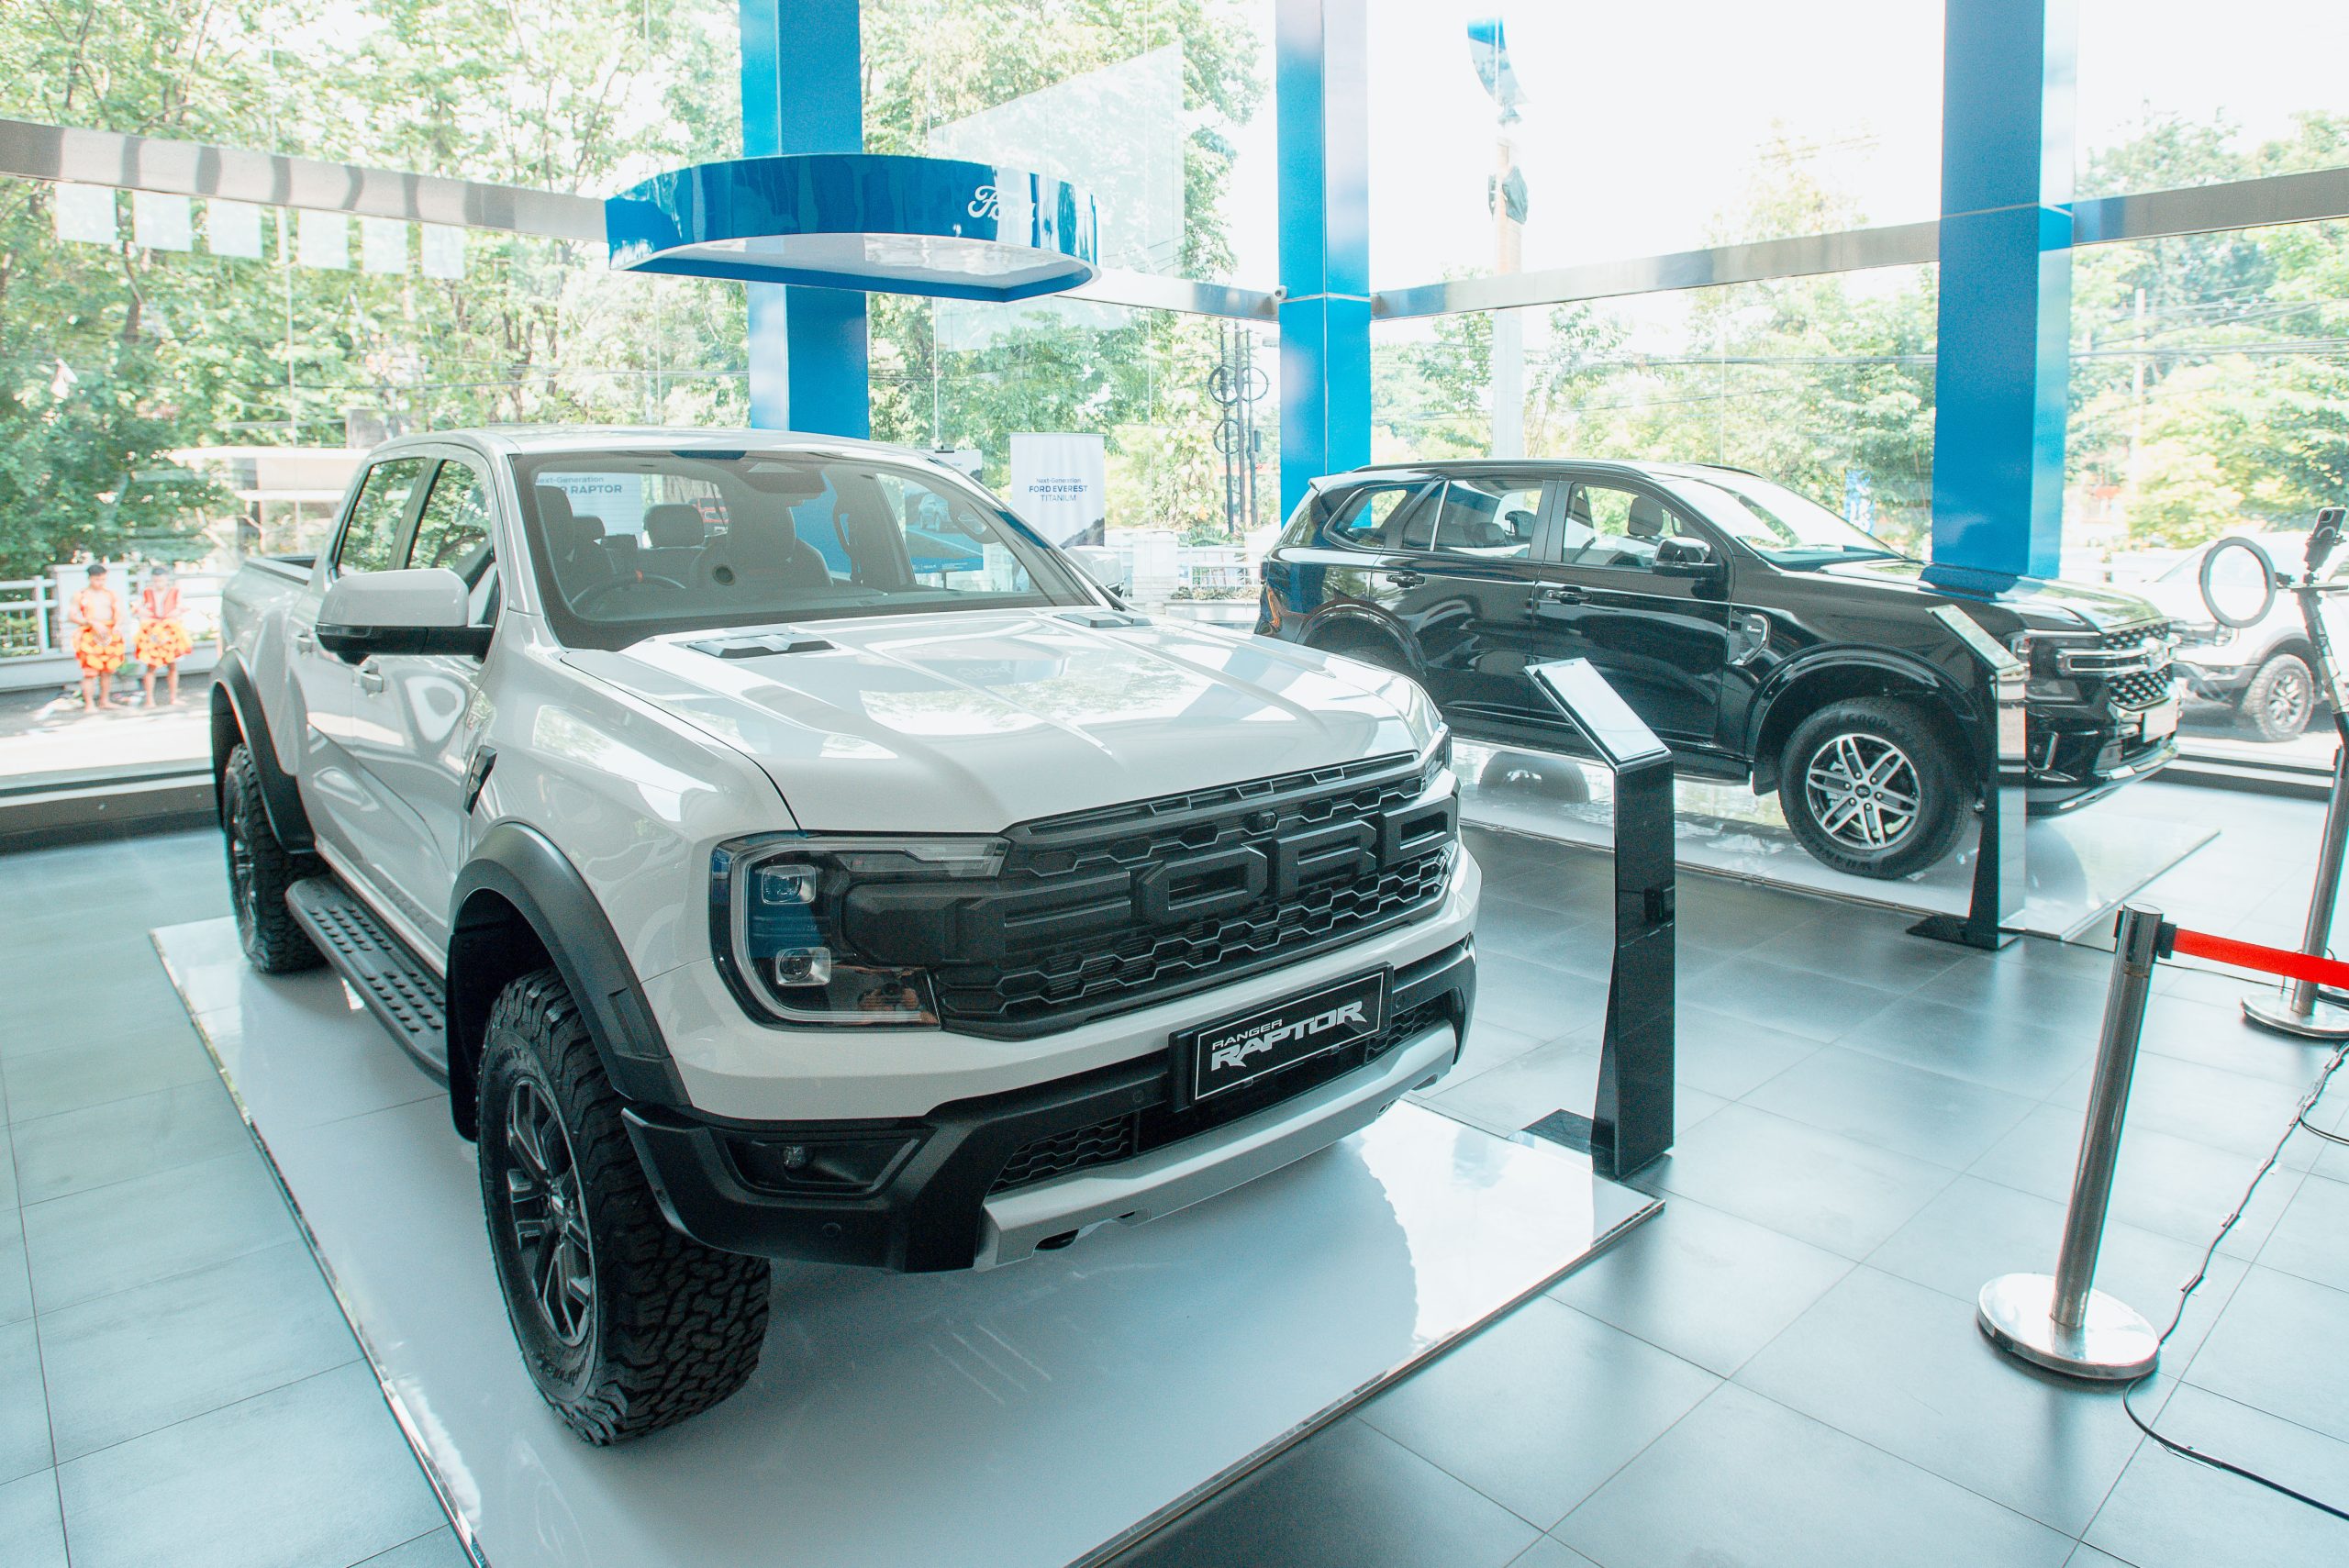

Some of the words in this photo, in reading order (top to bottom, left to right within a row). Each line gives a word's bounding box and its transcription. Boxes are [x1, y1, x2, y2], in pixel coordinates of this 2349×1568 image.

[968, 185, 1035, 221] For
[570, 484, 622, 494] RAPTOR
[963, 792, 1460, 962] FORD
[1210, 1001, 1367, 1072] RAPTOR
[1212, 1019, 1283, 1051] RANGER
